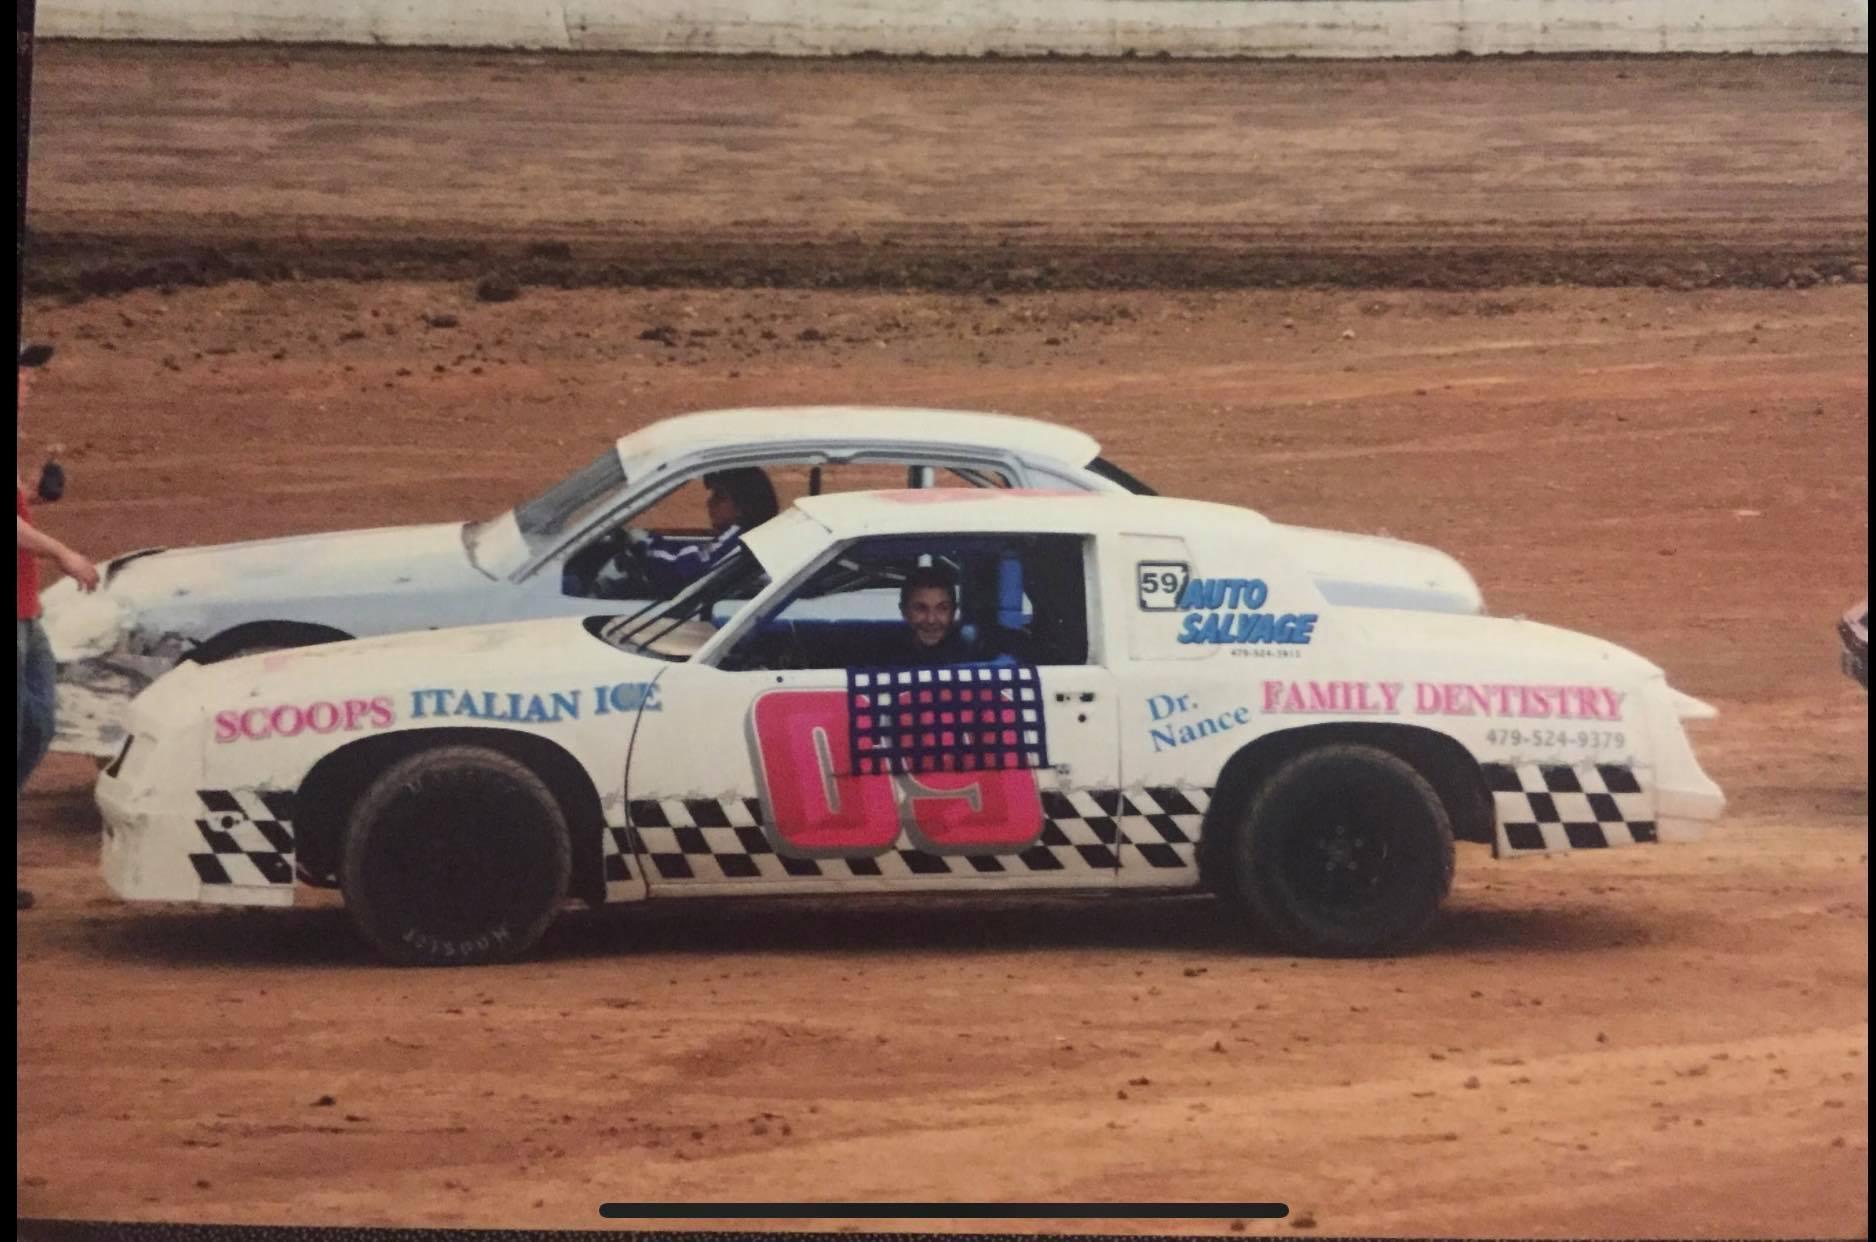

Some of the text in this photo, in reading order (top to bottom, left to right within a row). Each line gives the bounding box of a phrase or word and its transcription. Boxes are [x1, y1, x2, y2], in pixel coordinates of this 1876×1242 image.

[1142, 573, 1268, 610] 59 AUTO
[1177, 613, 1318, 644] SALVAGE
[213, 681, 663, 743] SCOOPS ITALIAN ICE
[1145, 691, 1199, 722] Dr.
[1260, 680, 1626, 722] FAMILY DENTISTRY
[1148, 702, 1251, 753] Nance
[1485, 728, 1626, 749] 479-524-9379
[744, 687, 1046, 860] 09
